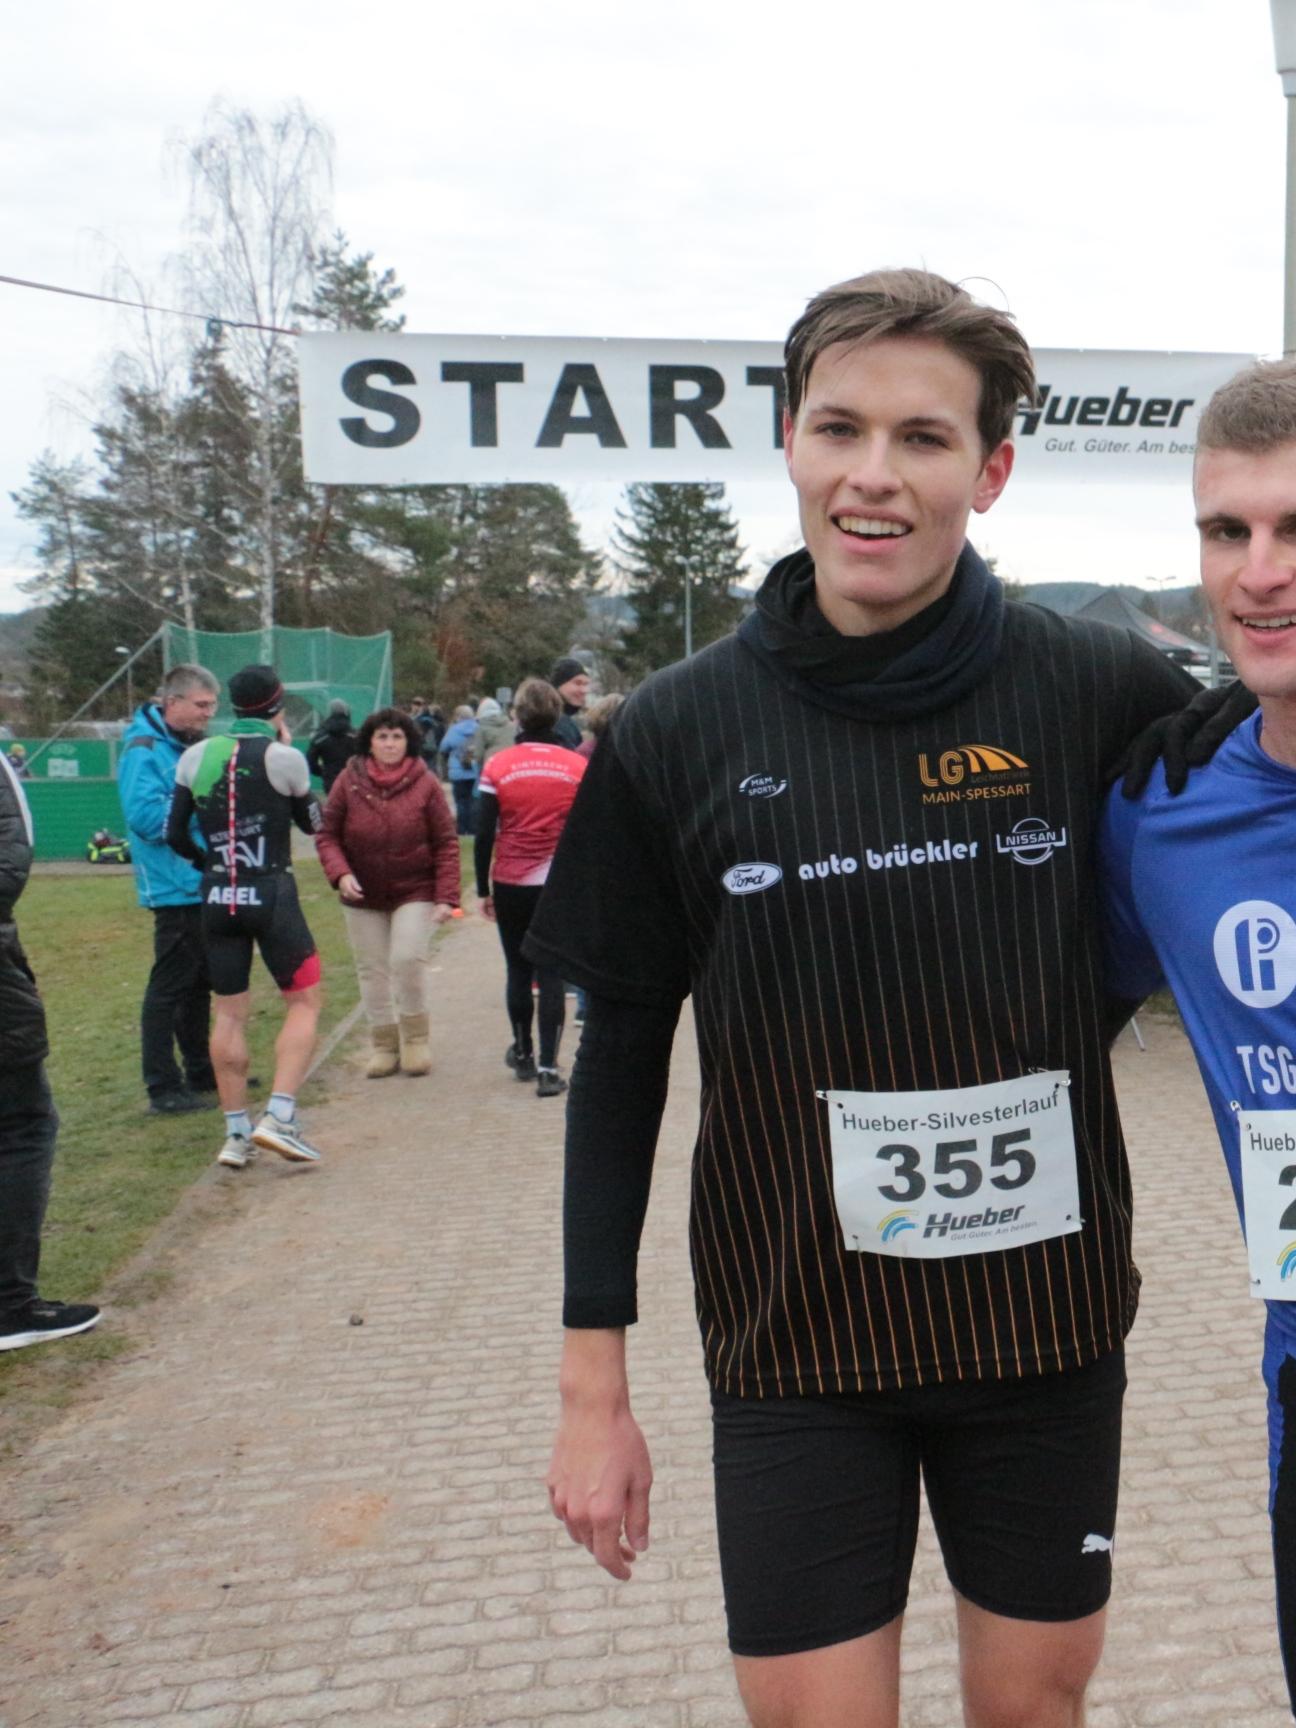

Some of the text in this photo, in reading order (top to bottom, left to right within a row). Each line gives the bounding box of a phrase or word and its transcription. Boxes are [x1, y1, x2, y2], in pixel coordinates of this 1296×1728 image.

[1044, 438, 1077, 453] Gut.
[1084, 438, 1131, 453] Güter.
[1136, 440, 1163, 453] Am
[918, 750, 964, 787] LG
[748, 785, 777, 796] SPORTS
[922, 783, 1032, 805] MAIN-SPESSART
[1005, 832, 1057, 847] NISSAN
[798, 839, 979, 881] auto brückler
[207, 886, 262, 905] ABEL
[842, 1091, 1060, 1132] Hueber-Silvesterlauf
[875, 1127, 1037, 1203] 355
[922, 1204, 1026, 1239] Hueber
